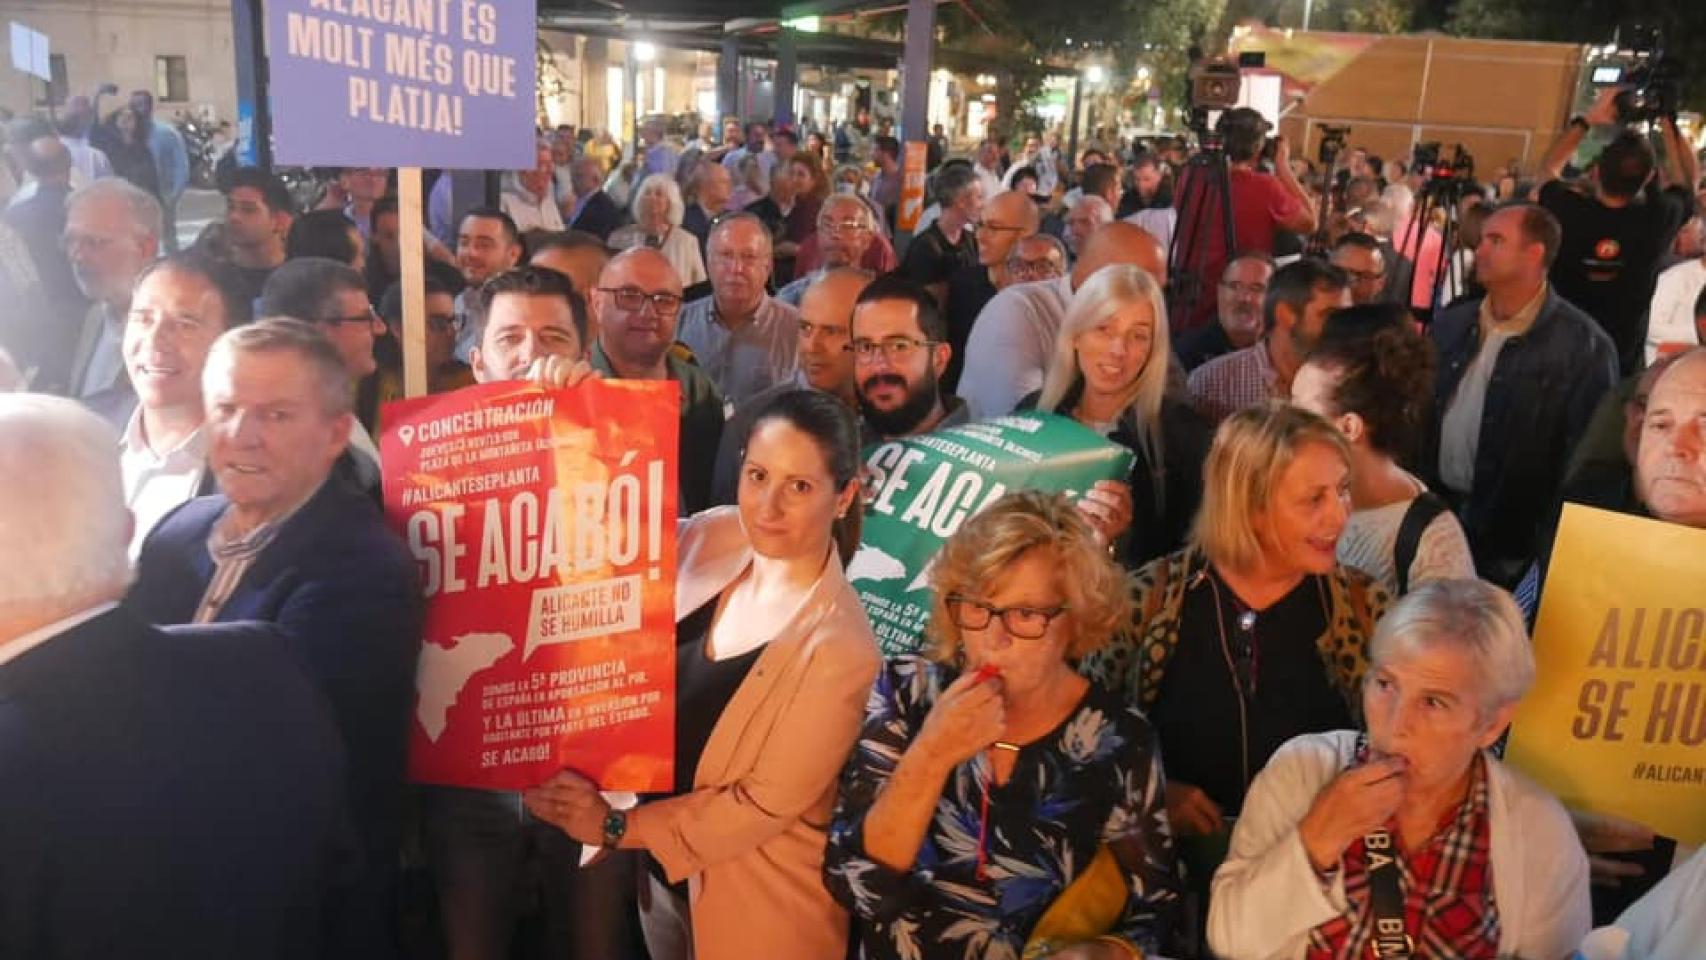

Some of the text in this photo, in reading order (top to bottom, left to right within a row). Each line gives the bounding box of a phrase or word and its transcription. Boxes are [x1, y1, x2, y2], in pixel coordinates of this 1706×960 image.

[310, 0, 449, 35] CANT
[287, 12, 517, 97] MOLT MÉS QUE
[348, 76, 463, 136] PLATJA!
[417, 397, 555, 443] CONCENTRACIÓN
[861, 442, 925, 516] SE
[408, 450, 664, 599] SE ACABÓ!
[541, 581, 631, 614] ALICANTE NO
[540, 605, 625, 637] SE HUMILLA
[1588, 607, 1706, 672] ALIC
[551, 660, 626, 688] PROVINCIA
[482, 715, 492, 731] Y
[495, 712, 512, 730] LA
[1571, 678, 1636, 741] SE
[482, 750, 499, 768] SE
[1632, 762, 1706, 784] #ALICAN
